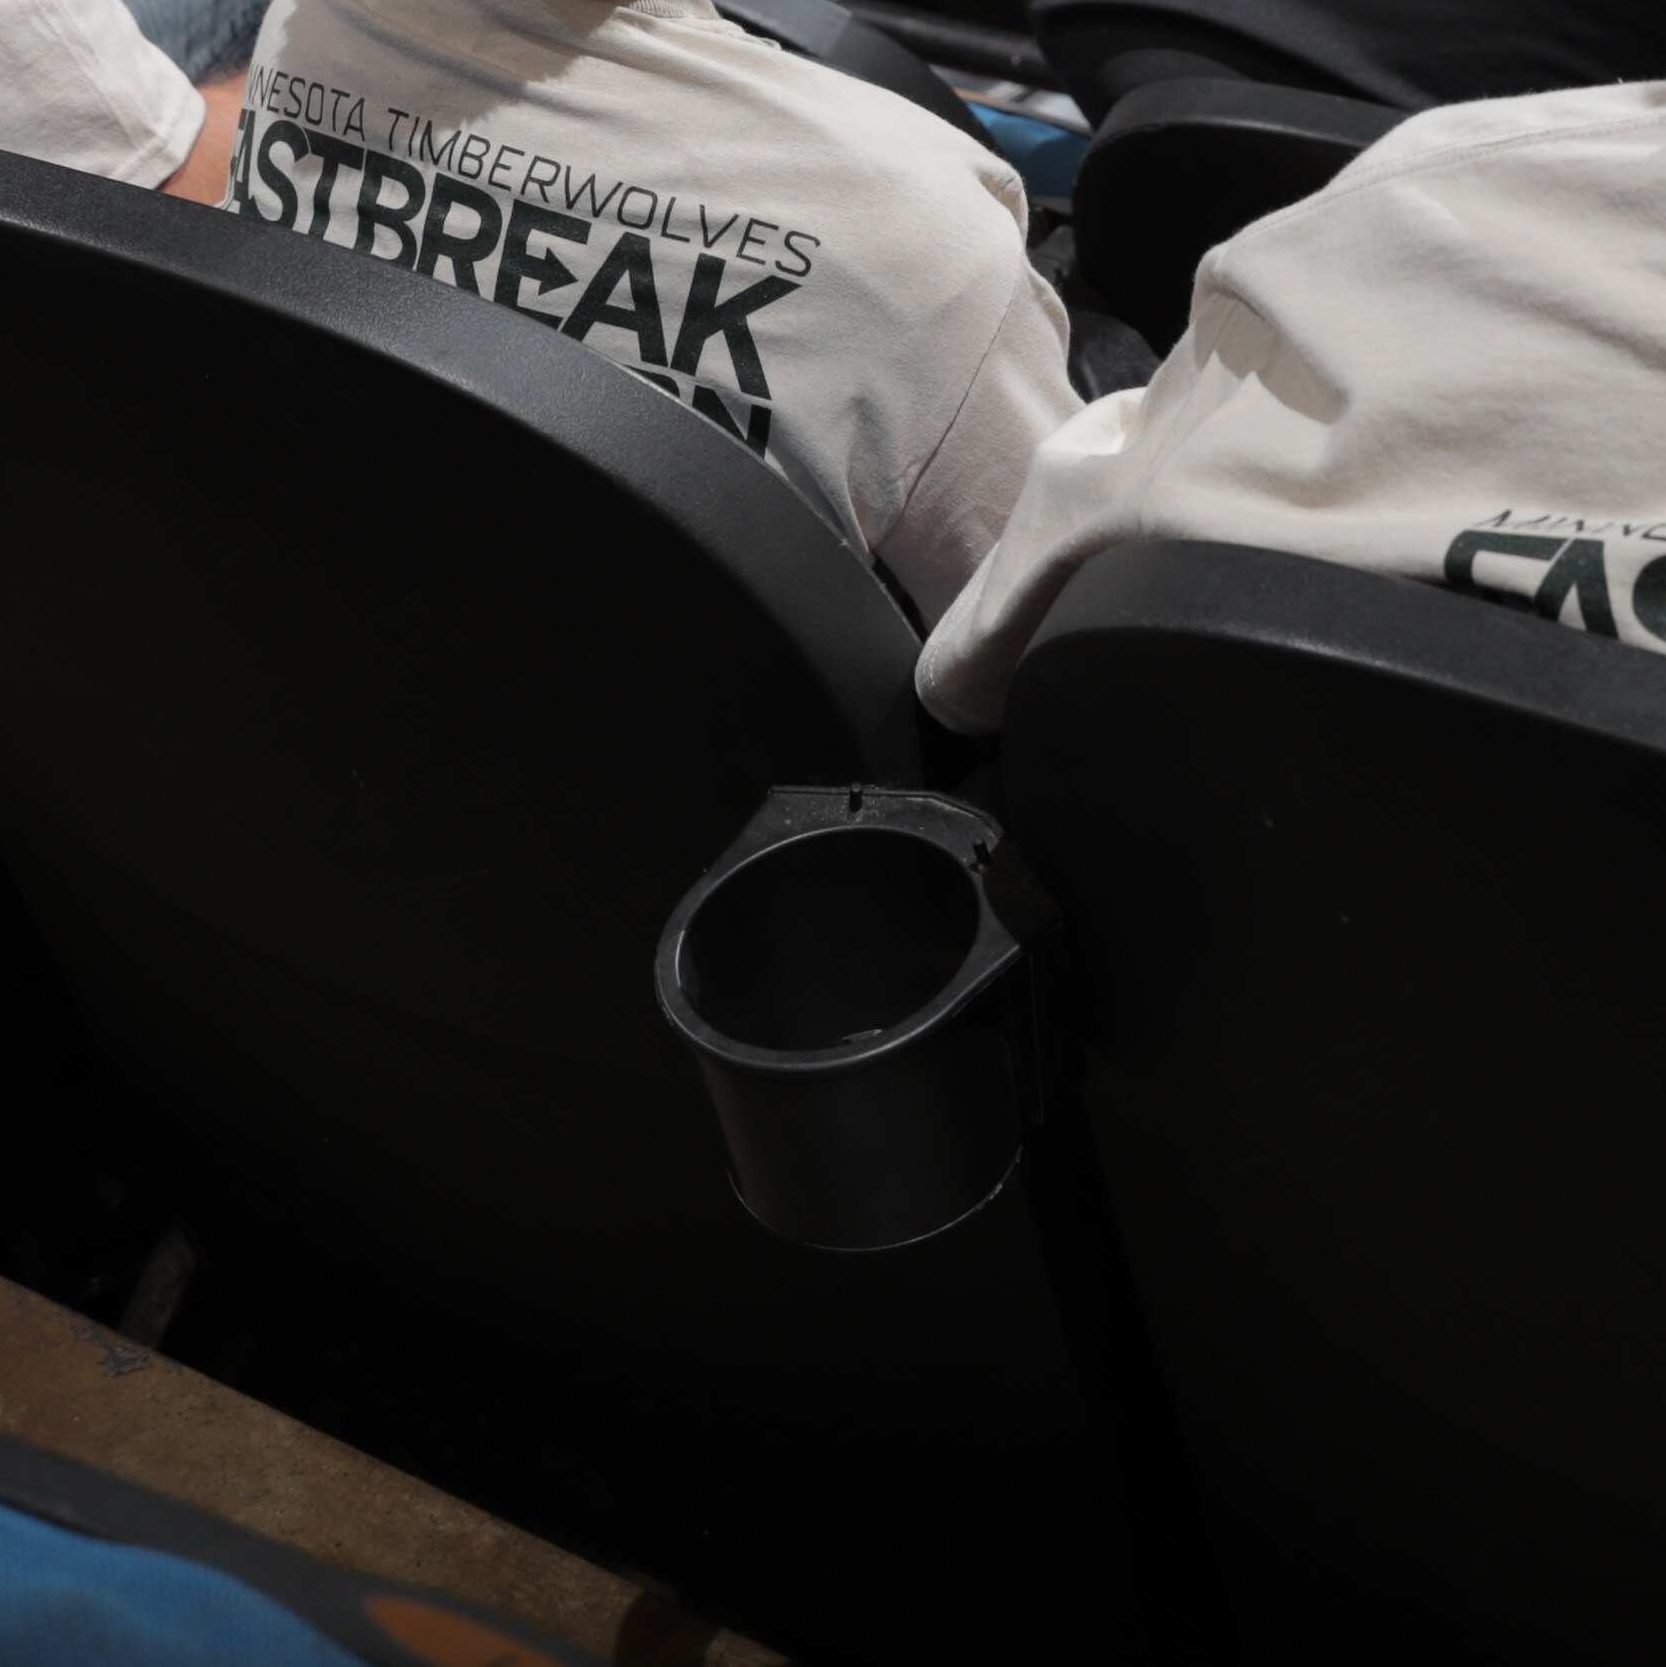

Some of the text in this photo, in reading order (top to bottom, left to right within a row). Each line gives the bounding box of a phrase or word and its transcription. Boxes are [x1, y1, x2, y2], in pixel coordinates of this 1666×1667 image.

[230, 107, 803, 401] ASTBREAK
[247, 63, 821, 278] NESOTA TIMBERWOLVES
